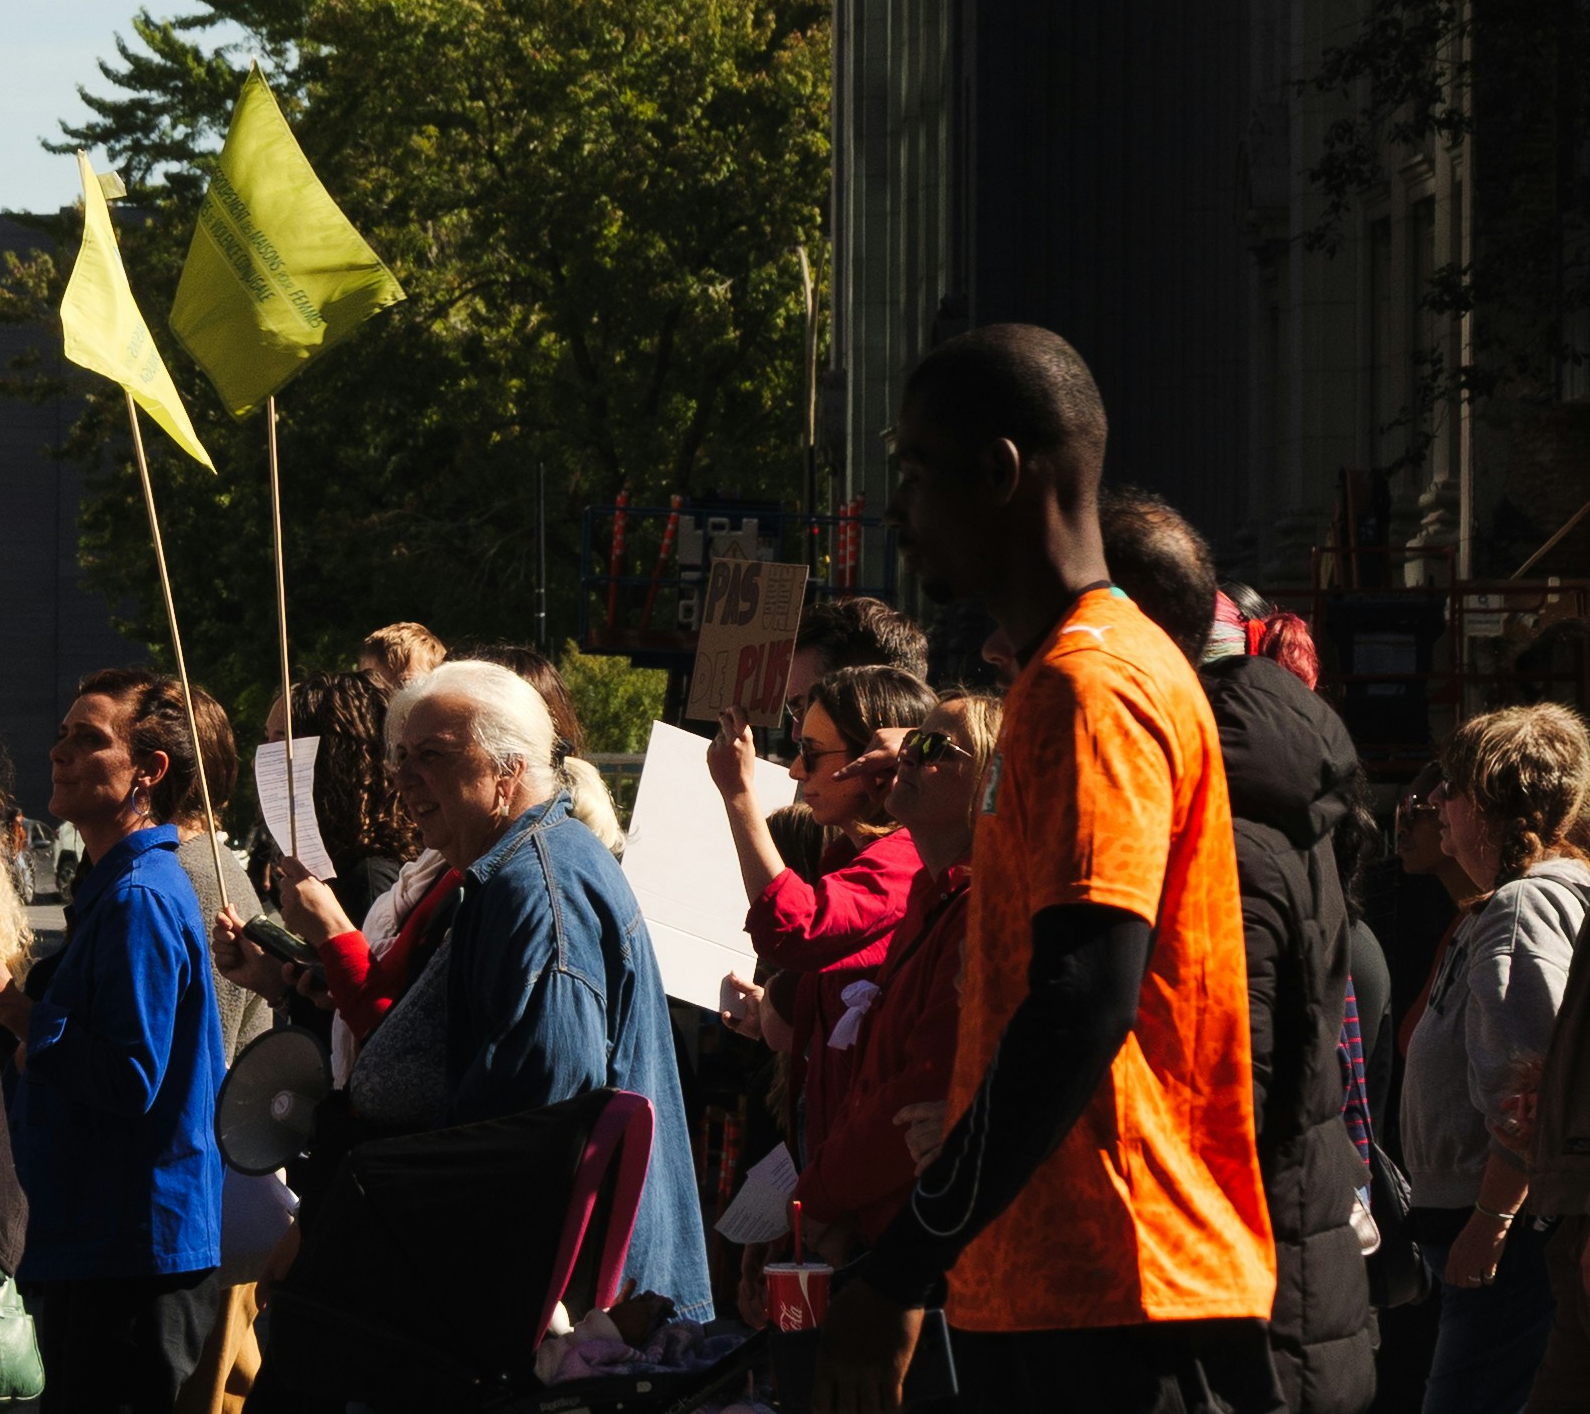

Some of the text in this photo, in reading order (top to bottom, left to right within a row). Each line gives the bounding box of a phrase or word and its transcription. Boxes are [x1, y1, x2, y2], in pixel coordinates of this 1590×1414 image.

[233, 253, 274, 303] CONJUGALE
[250, 230, 284, 272] MAISONS
[705, 562, 762, 626] PAS
[691, 638, 794, 714] DE PLUS
